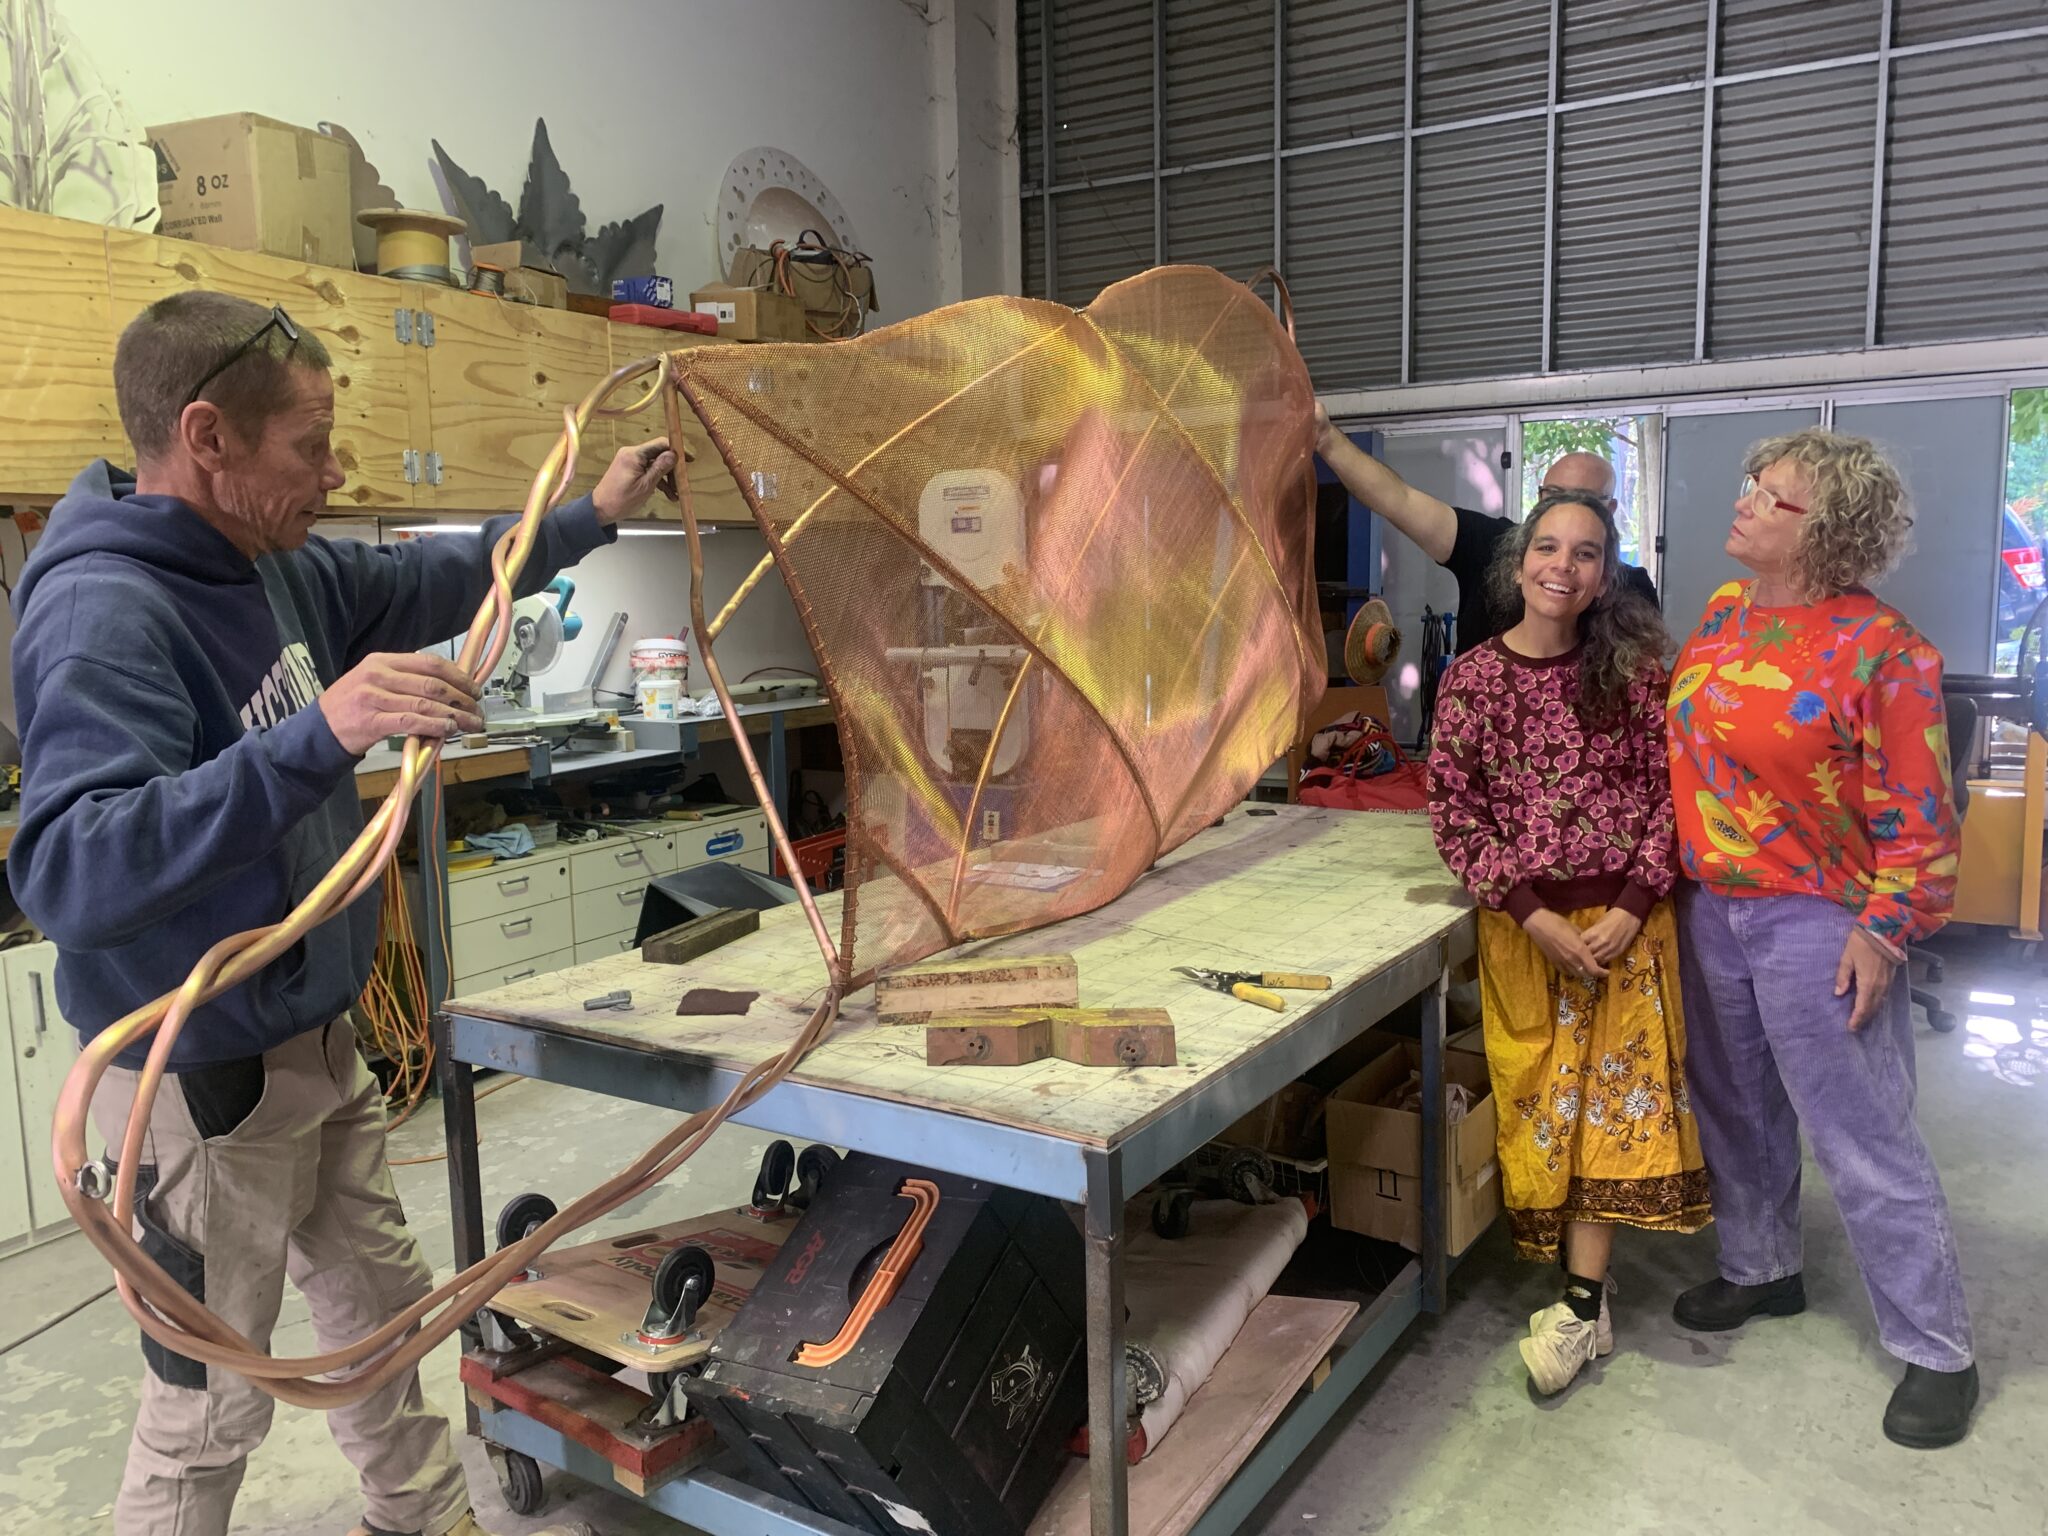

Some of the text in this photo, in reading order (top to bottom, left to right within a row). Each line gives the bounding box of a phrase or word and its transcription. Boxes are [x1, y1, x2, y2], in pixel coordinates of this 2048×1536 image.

[197, 174, 229, 196] 8 OZ
[1368, 807, 1428, 816] COUNTRY ROAD
